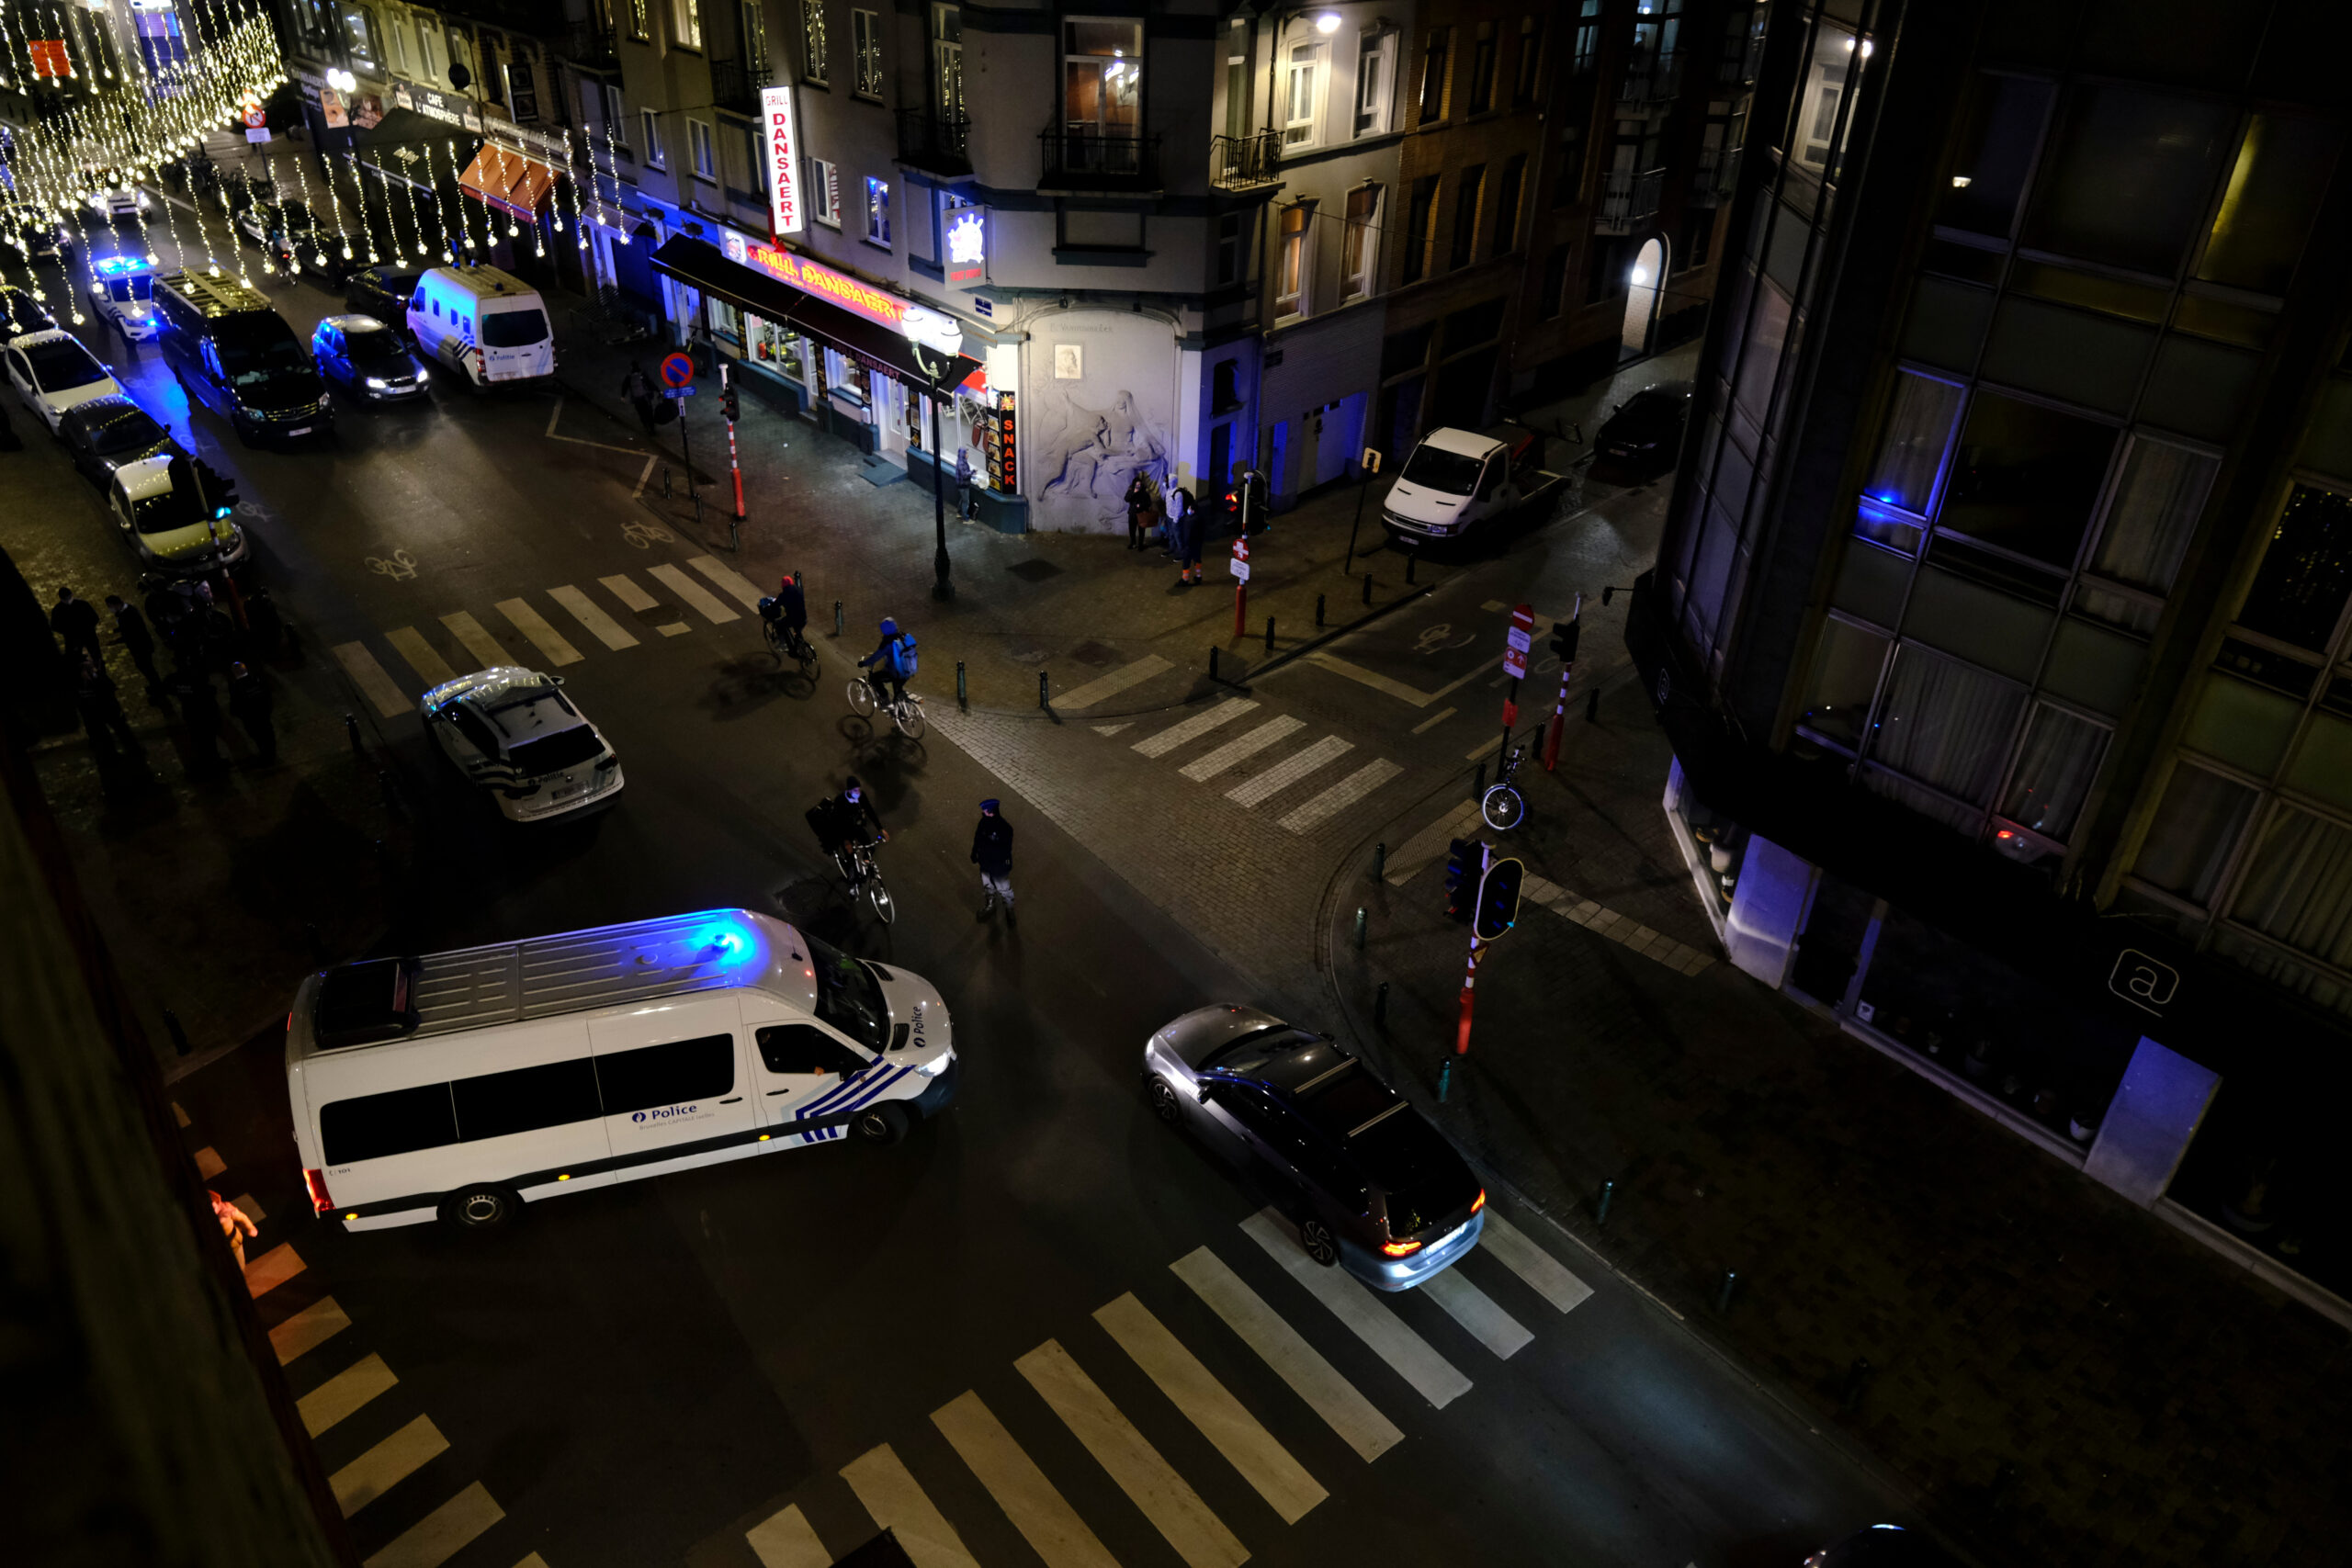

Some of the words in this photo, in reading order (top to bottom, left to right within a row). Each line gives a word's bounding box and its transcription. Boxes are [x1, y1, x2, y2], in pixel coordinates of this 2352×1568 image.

[765, 96, 788, 107] GRILL
[773, 113, 794, 227] DANSAERT
[748, 244, 798, 277] GRILL
[802, 265, 906, 321] DANSAERT
[855, 352, 901, 380] DANSAERT
[1003, 420, 1015, 485] SNACK
[911, 1006, 924, 1034] Police
[639, 1121, 667, 1131] Bruxelles
[668, 1116, 695, 1126] CAPITALE
[651, 1104, 697, 1120] Police
